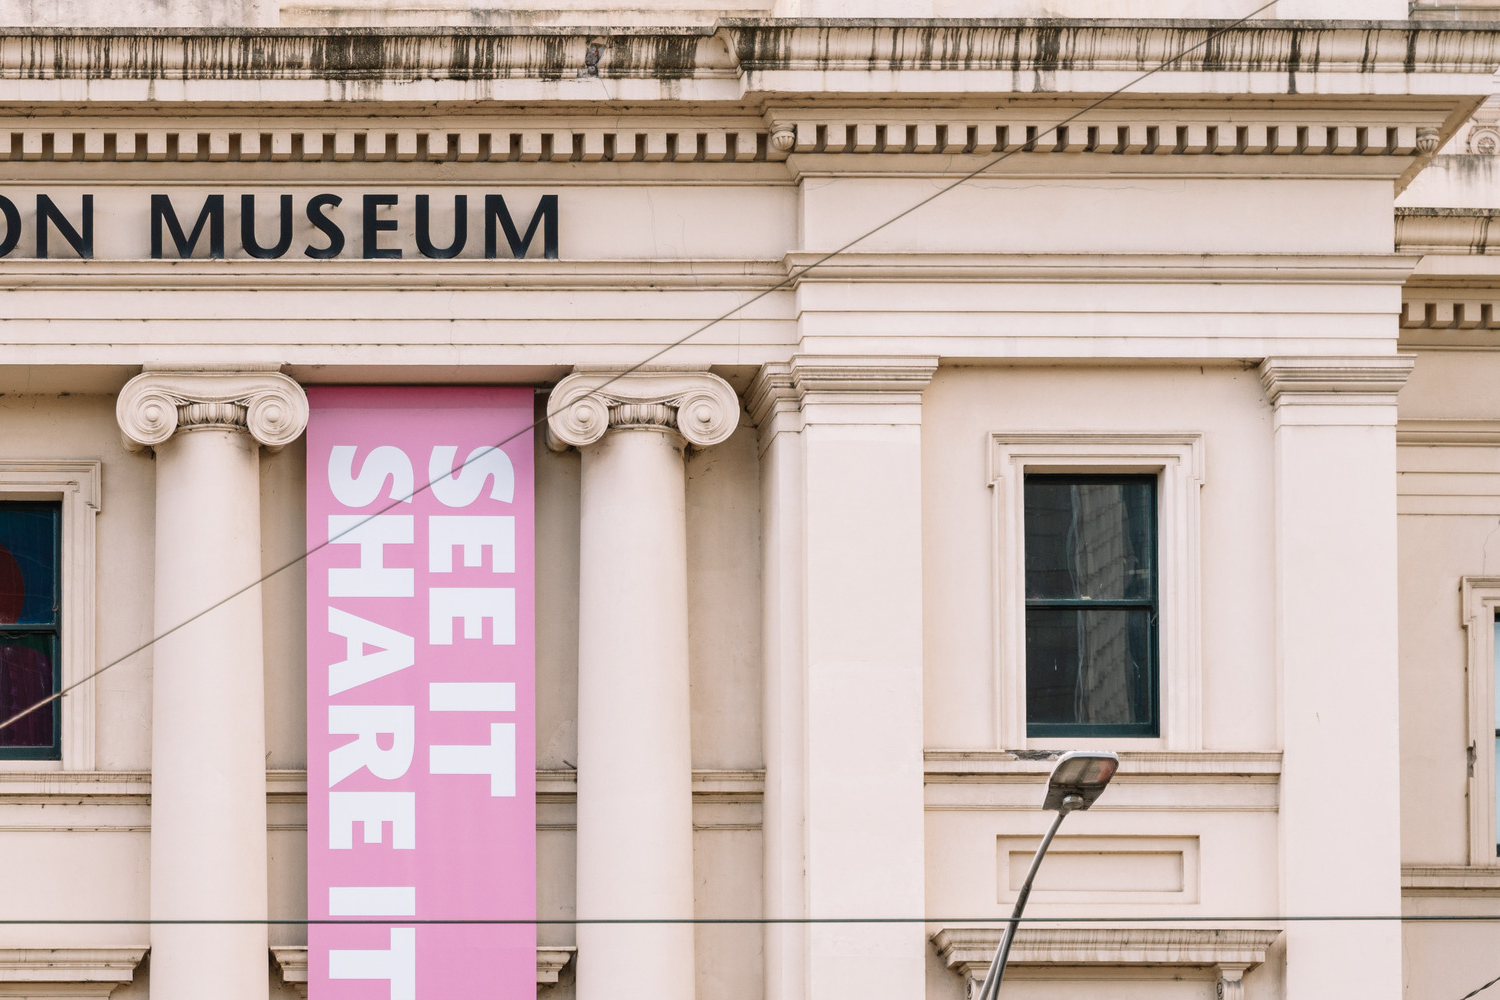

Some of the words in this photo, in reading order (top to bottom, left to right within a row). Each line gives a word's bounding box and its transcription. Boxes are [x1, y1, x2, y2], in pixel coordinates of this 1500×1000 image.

[150, 193, 559, 260] MUSEUM
[428, 446, 515, 645] SEE
[328, 446, 415, 849] SHARE
[429, 682, 516, 797] IT
